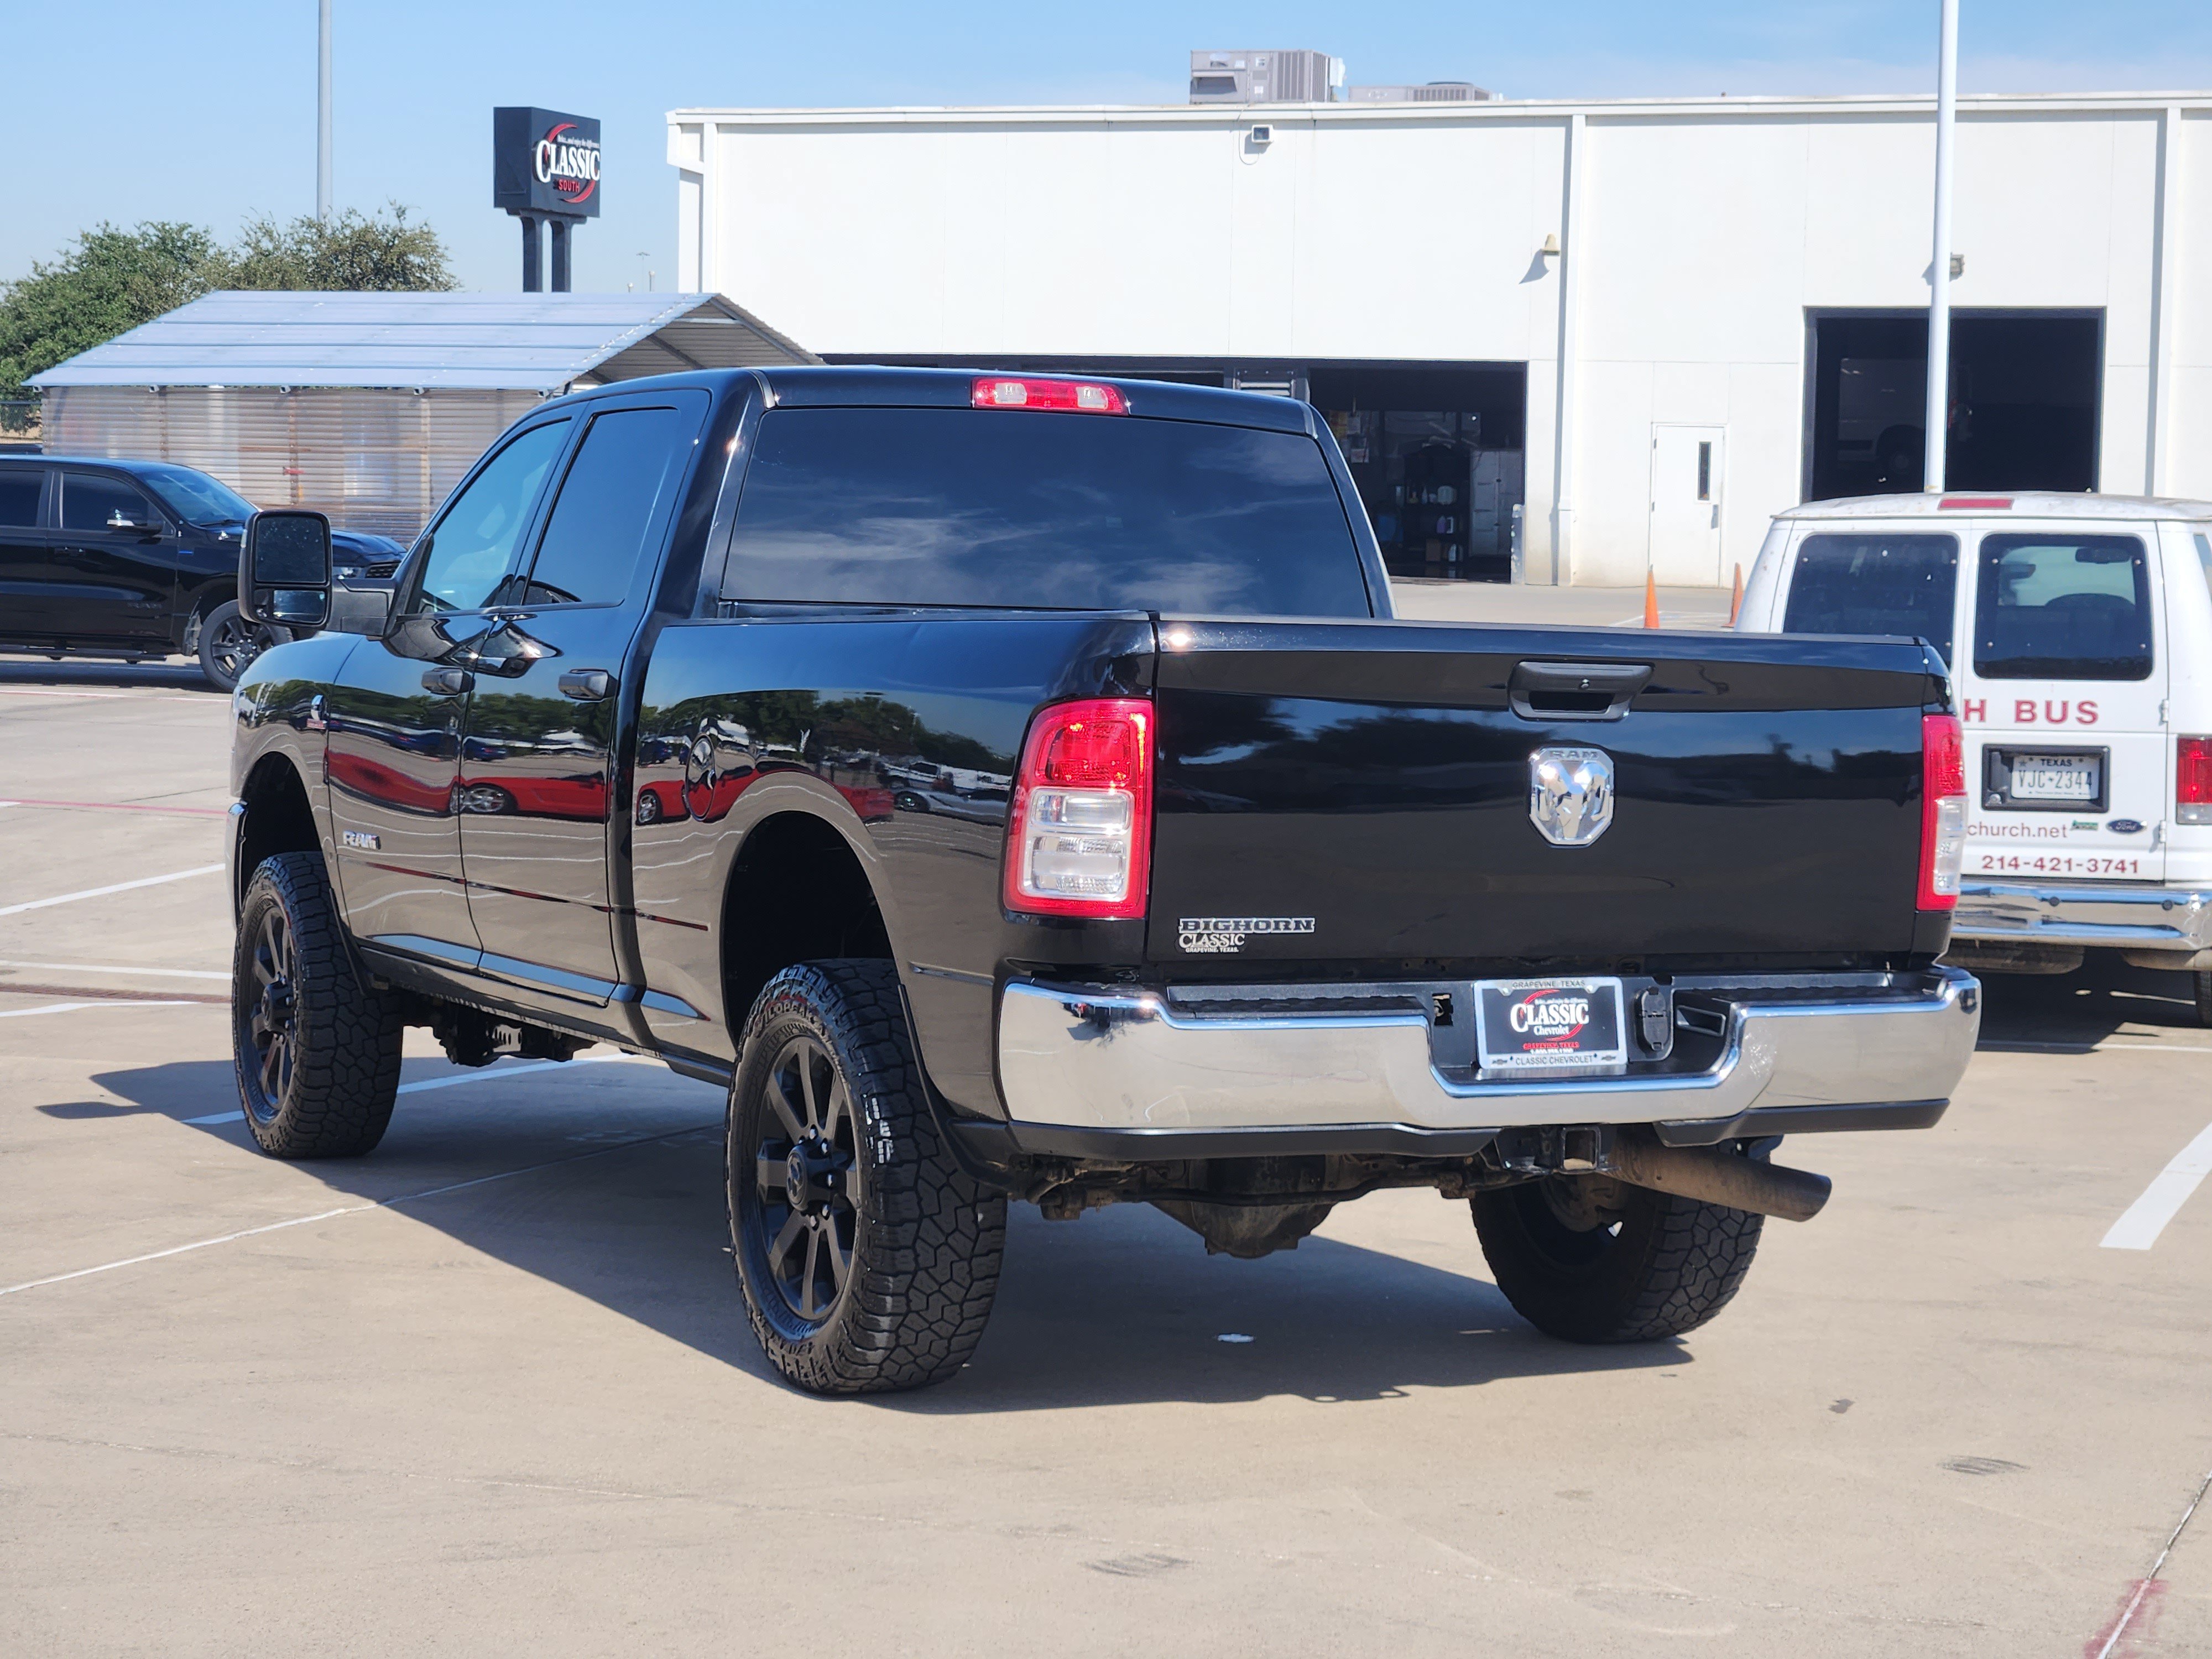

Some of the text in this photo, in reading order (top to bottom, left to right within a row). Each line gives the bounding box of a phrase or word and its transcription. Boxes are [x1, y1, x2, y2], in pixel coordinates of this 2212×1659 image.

[536, 140, 600, 182] CLASSIC
[559, 179, 580, 192] SOUTH
[2015, 700, 2099, 725] BUS
[1550, 750, 1599, 759] RAM
[2041, 758, 2073, 767] TEXAS
[343, 831, 382, 850] RAM
[1982, 855, 2139, 874] 214-421-3741
[1179, 917, 1315, 933] BIGHORN
[1179, 933, 1245, 948] CLASSIC
[1510, 1003, 1589, 1032] CLASSIC
[1533, 1025, 1569, 1036] Chevrolet
[1516, 1055, 1593, 1065] CLASSIC CHEVROLET
